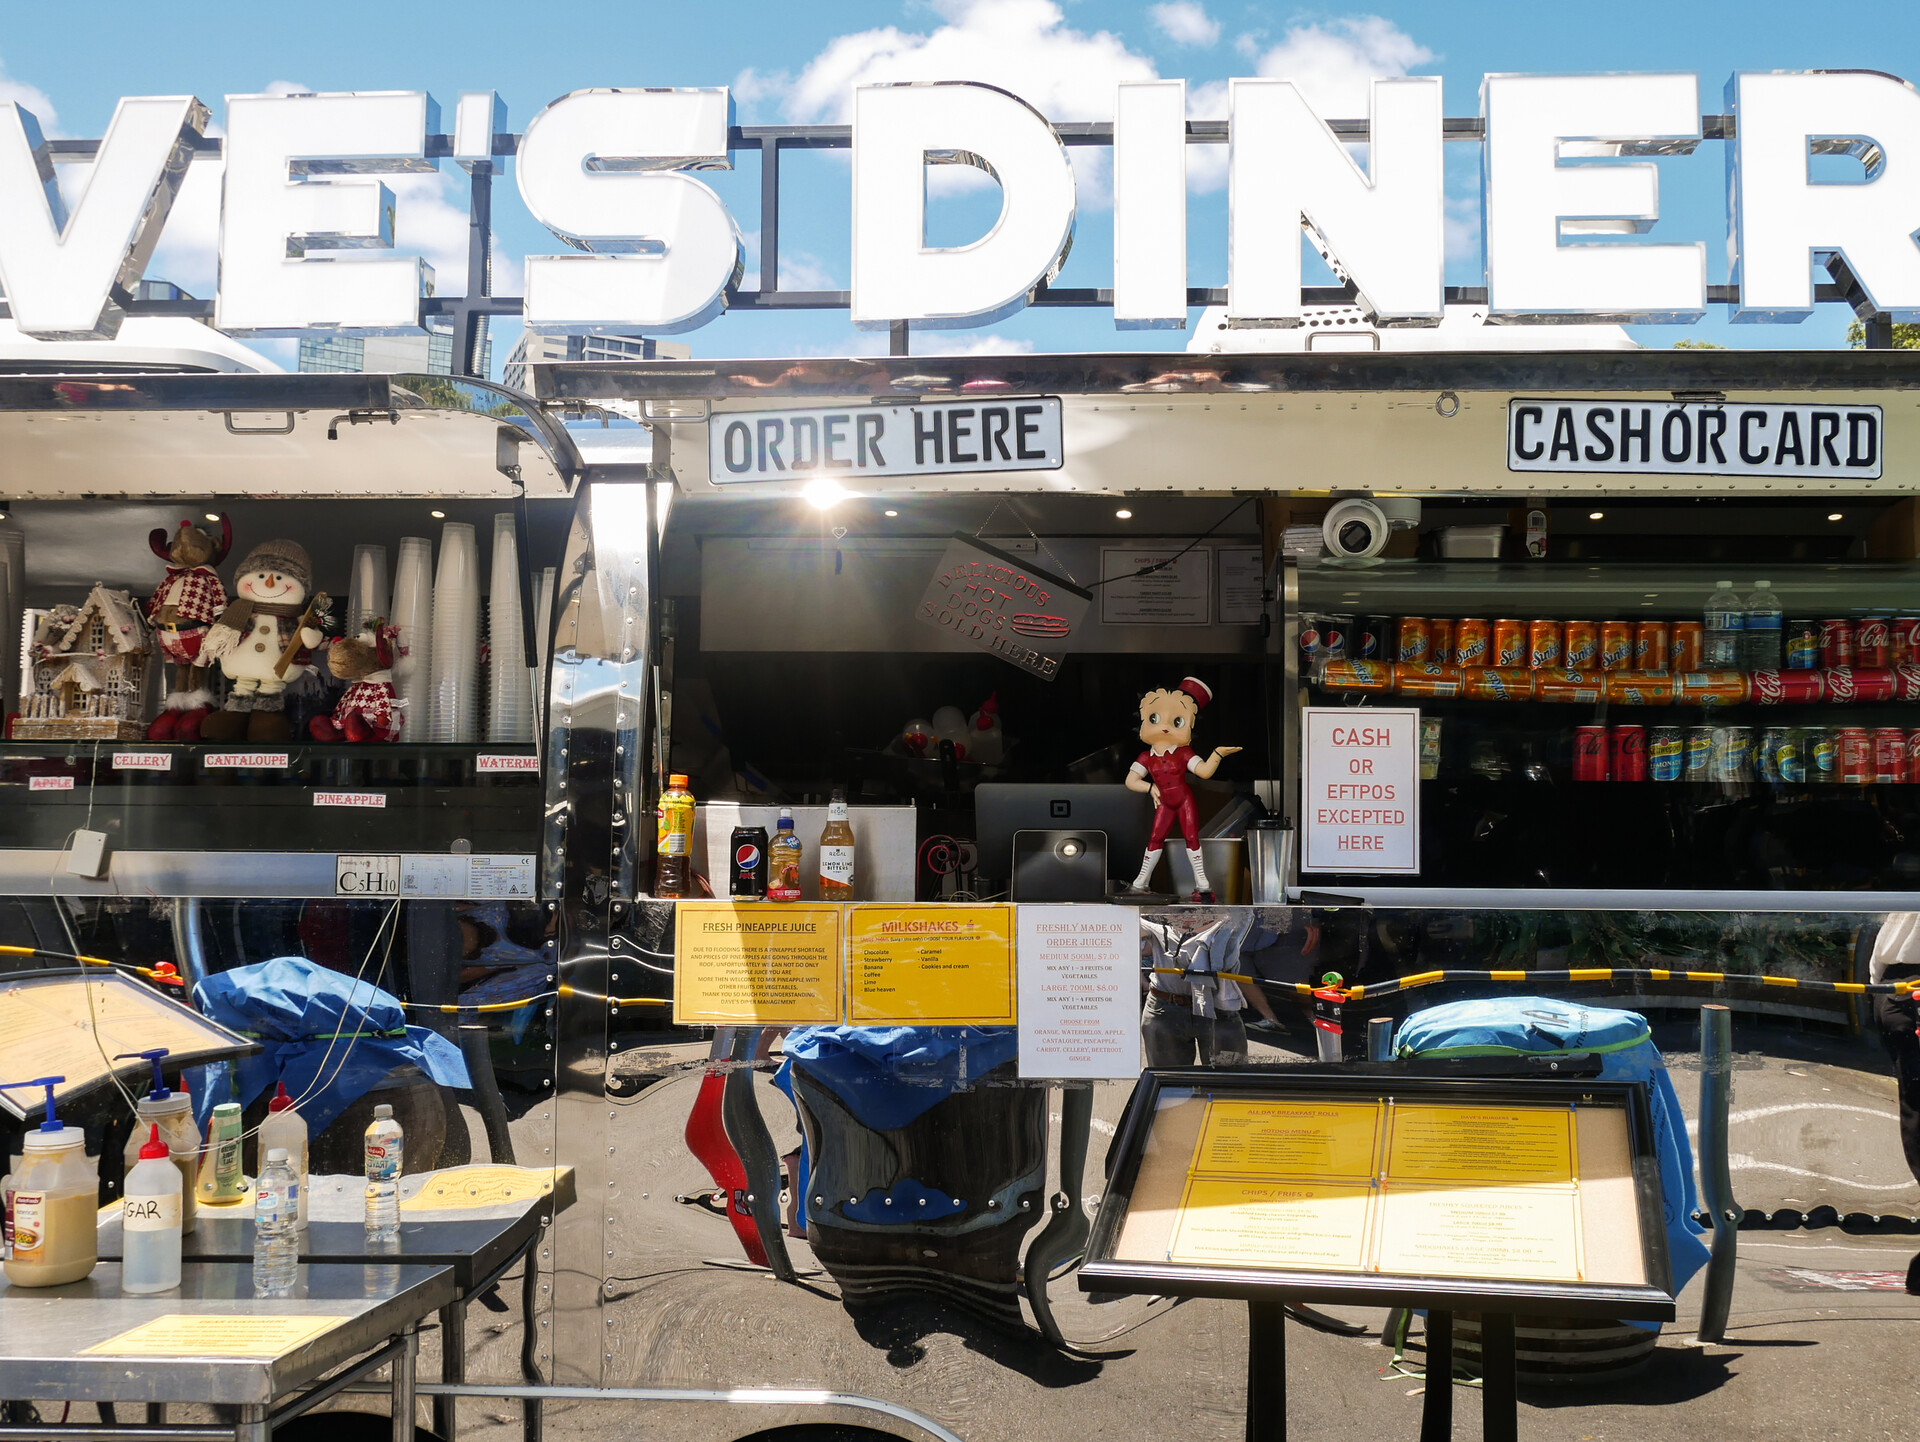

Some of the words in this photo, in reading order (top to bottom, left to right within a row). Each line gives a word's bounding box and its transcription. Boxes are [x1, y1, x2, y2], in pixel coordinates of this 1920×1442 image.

[852, 68, 1920, 331] DINER
[725, 413, 886, 473] ORDER
[914, 405, 1045, 464] HERE
[939, 562, 1050, 607] DELICIOUS
[964, 578, 1012, 610] HOT
[947, 592, 1007, 630] DOGS
[921, 601, 984, 640] SOLD
[989, 633, 1057, 675] HERE
[1456, 636, 1488, 665] Sunkist
[1332, 728, 1390, 745] CASH
[114, 755, 170, 766] CELLERY
[206, 756, 286, 766] CANTALOUPE
[1349, 759, 1373, 774] OR
[33, 779, 72, 788] APPLE
[1328, 784, 1395, 799] EFTPOS
[316, 794, 383, 805] PINEAPPLE
[1317, 809, 1405, 824] EXCEPTED
[1338, 835, 1384, 849] HERE
[703, 923, 732, 931] FRESH
[736, 923, 787, 931] PINEAPPLE
[790, 923, 816, 931] JUICE
[882, 921, 958, 932] MILKSHAKES
[1036, 923, 1078, 932] FRESHLY
[1081, 924, 1107, 932] MADE
[1110, 924, 1122, 932] ON
[1047, 938, 1077, 946] ORDER
[1080, 938, 1112, 946] JUICES
